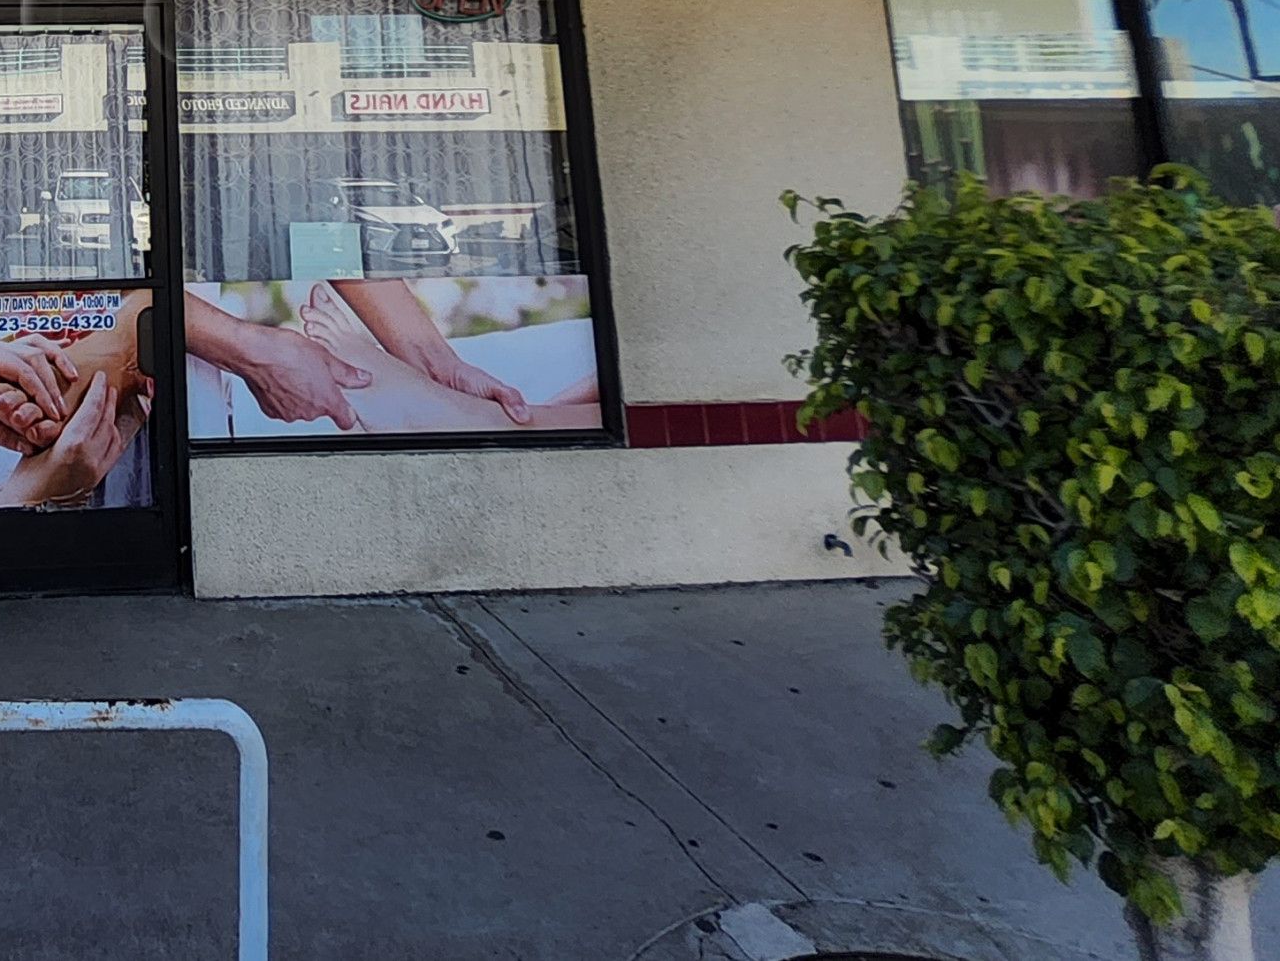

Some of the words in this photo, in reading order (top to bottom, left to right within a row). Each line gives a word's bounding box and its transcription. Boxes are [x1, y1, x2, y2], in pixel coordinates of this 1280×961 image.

[3, 298, 10, 311] 7
[12, 298, 34, 311] DAYS
[37, 297, 59, 309] 10:00
[62, 296, 75, 309] AM
[83, 296, 104, 309] 10:00
[107, 295, 119, 308] PM
